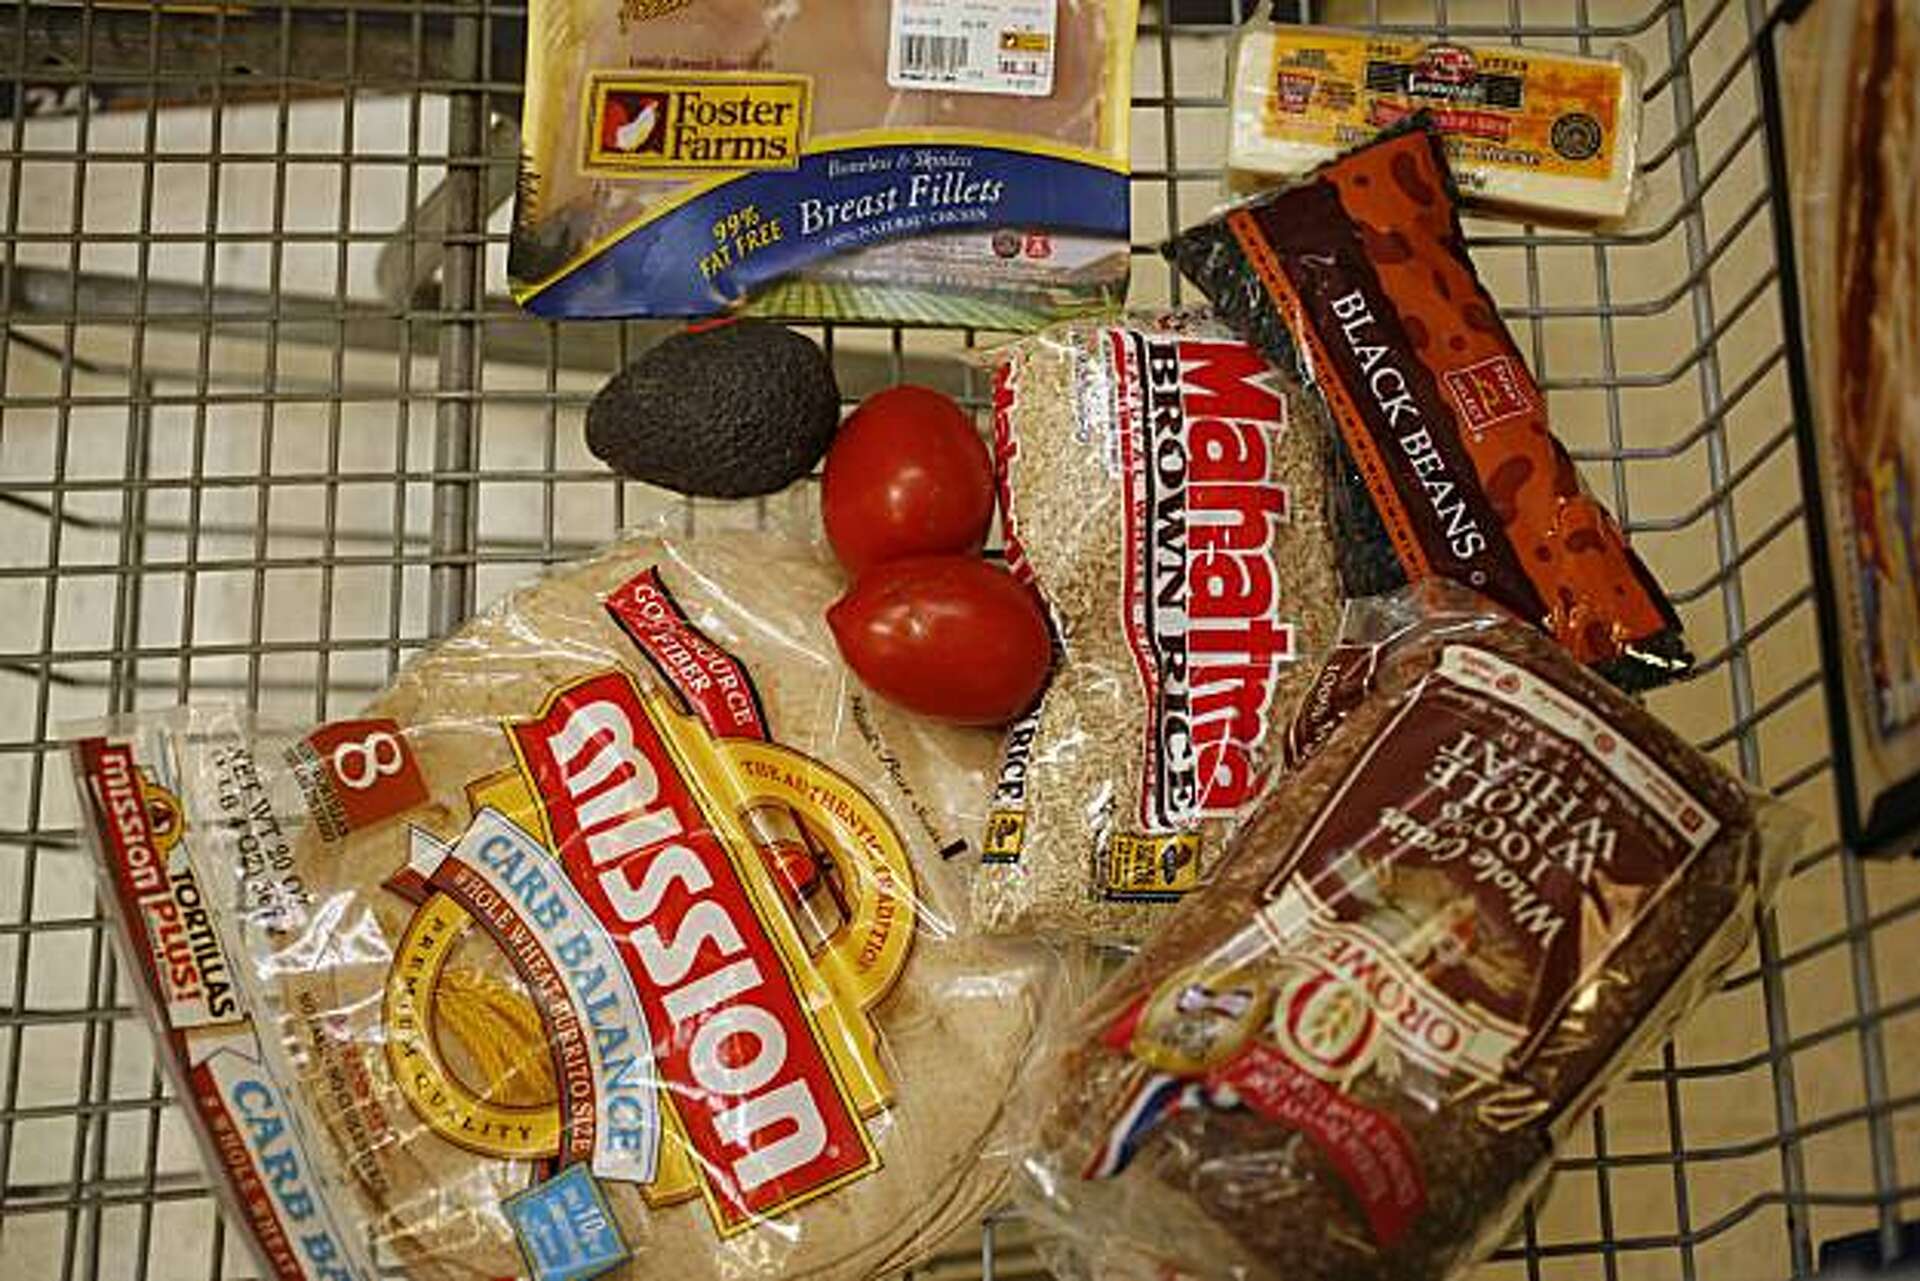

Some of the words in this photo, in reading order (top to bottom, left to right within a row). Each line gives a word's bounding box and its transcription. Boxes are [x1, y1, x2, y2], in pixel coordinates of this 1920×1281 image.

[670, 125, 788, 161] Farms
[676, 90, 793, 127] Foster
[800, 186, 899, 235] Breast
[908, 169, 1004, 208] Fillets
[827, 156, 893, 179] Boneless
[913, 150, 974, 172] Skinless
[698, 244, 733, 279] FAT
[734, 217, 785, 261] FREE
[712, 203, 761, 244] 99%
[929, 206, 988, 225] CHICKEN
[1331, 287, 1415, 430] BLACK
[1398, 416, 1487, 564] BEANS
[1150, 343, 1187, 610] BROWN
[1176, 340, 1294, 813] Mahatma
[652, 629, 712, 694] FIBER
[334, 730, 404, 790] 8
[994, 726, 1036, 800] RICE
[1156, 632, 1197, 811] RICE
[227, 745, 263, 800] NET
[250, 797, 282, 842] WT
[1423, 754, 1596, 885] WHOLE
[1437, 729, 1619, 863] WHEAT
[1441, 799, 1552, 885] 100%
[171, 868, 236, 1019] TORTILLAS
[1470, 846, 1565, 950] Whole
[151, 897, 202, 1003] PLUS!
[480, 833, 572, 930] CARB
[557, 928, 645, 1157] BALANCE
[508, 920, 568, 1008] WHEAT
[552, 998, 596, 1102] BURRITO
[231, 1079, 316, 1223] CARB
[570, 1098, 597, 1157] SIZE
